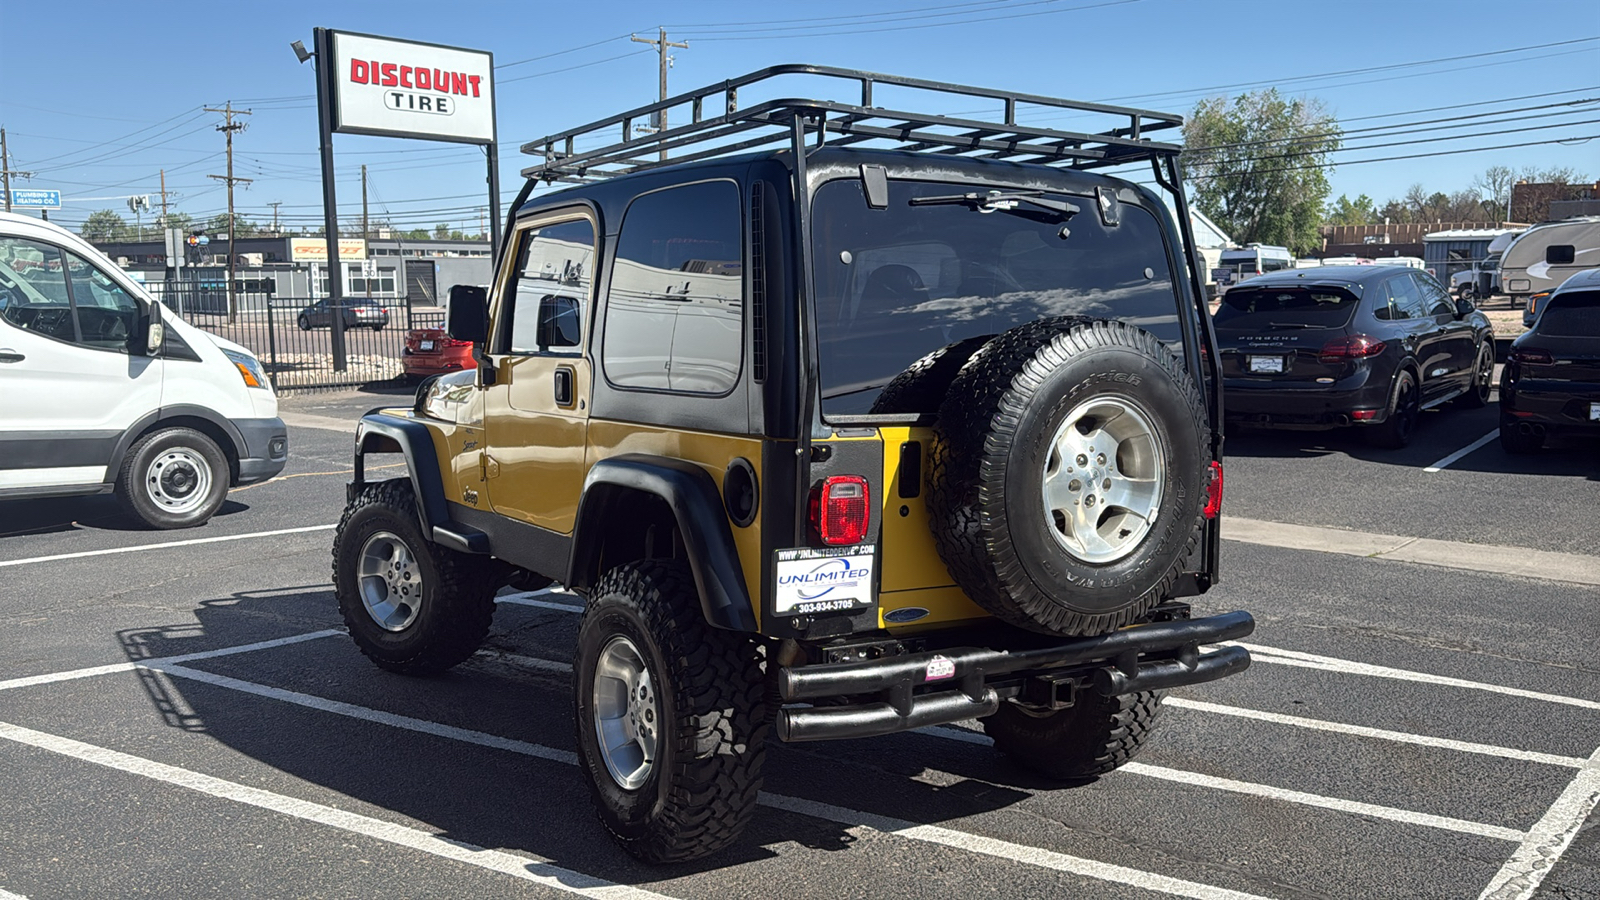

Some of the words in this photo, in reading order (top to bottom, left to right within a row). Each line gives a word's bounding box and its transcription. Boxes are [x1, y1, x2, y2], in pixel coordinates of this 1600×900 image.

[350, 57, 481, 98] DISCOUNT
[391, 92, 449, 113] TIRE
[363, 270, 376, 278] 30
[463, 485, 478, 507] Jeep
[779, 544, 875, 560] WWWUNLIMITEDDENVER.COM
[778, 568, 869, 584] UNLIMITED
[798, 599, 853, 614] 303-934-3705
